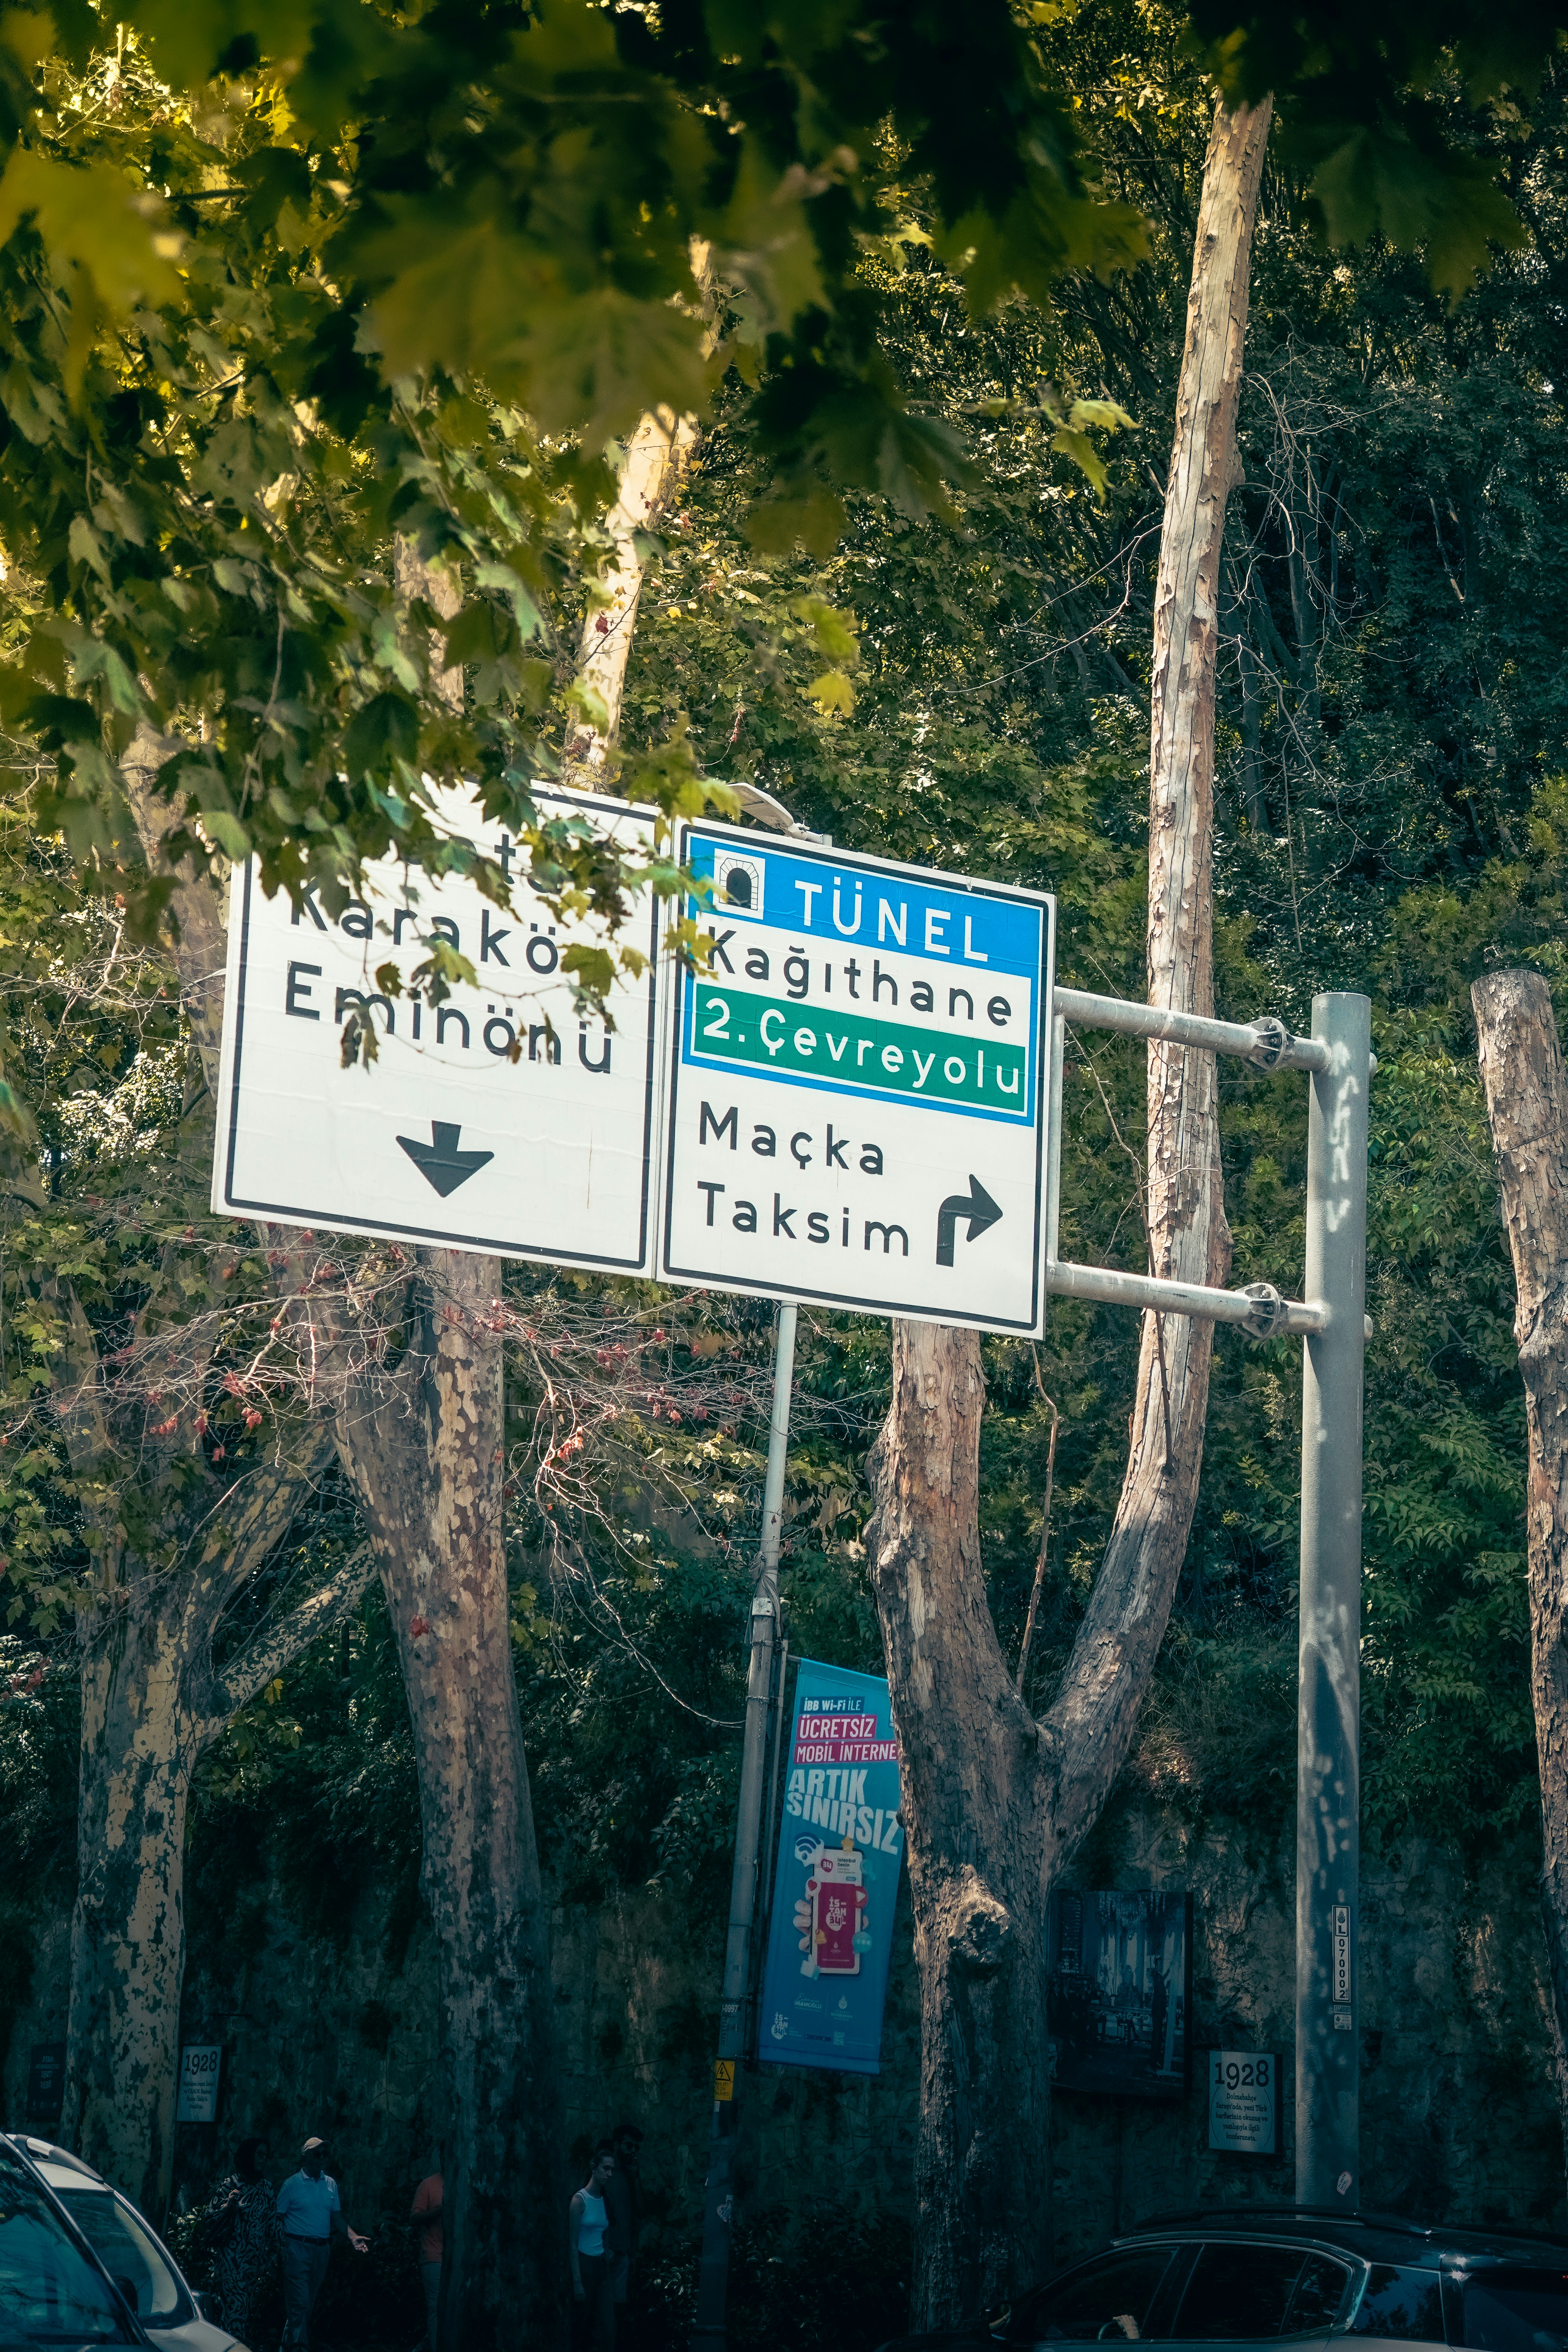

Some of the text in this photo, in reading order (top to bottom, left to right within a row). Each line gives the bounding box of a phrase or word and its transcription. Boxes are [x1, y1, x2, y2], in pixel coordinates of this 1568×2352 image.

[290, 877, 558, 975] Karakö
[795, 877, 988, 962] TÜNEL
[708, 926, 1011, 1026] Kağıthane
[285, 960, 611, 1074] Eminönü
[699, 1101, 883, 1176] Maçka
[697, 1181, 909, 1257] Taksim
[804, 1697, 819, 1711] İBB
[848, 1697, 862, 1711] İLE
[800, 1713, 874, 1739] ÜCRETSİZ
[796, 1740, 897, 1762] MOBİL İNTERNE
[788, 1769, 868, 1806] ARTIK
[786, 1791, 899, 1855] SINIRSIZ
[184, 2051, 218, 2075] 1928
[1215, 2059, 1269, 2090] 1928
[1226, 2093, 1257, 2102] Dolmabahçe
[1215, 2111, 1242, 2120] harflerinin
[1242, 2114, 1261, 2123] okunuş
[1249, 2123, 1260, 2133] ilgili
